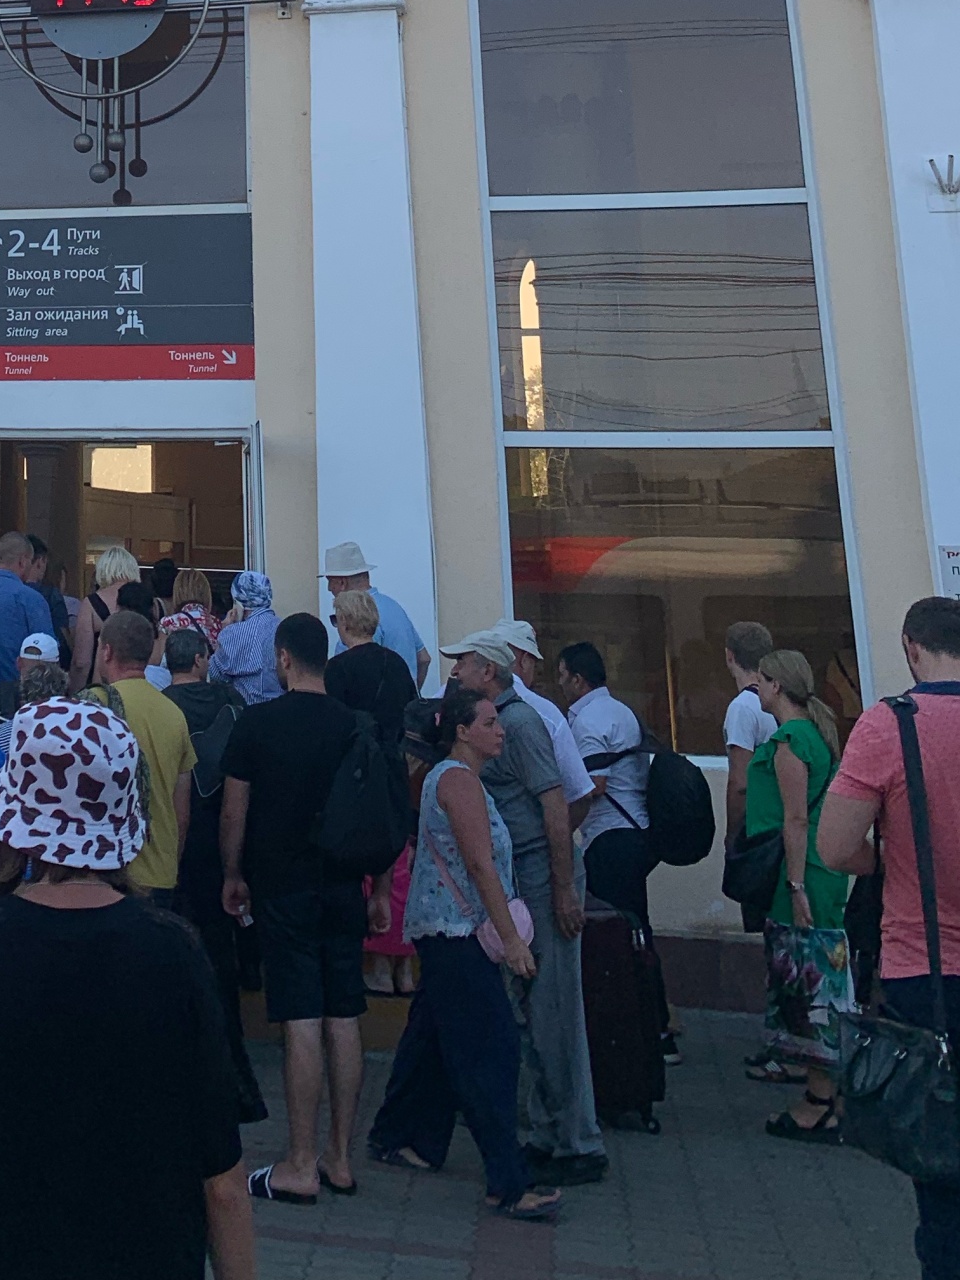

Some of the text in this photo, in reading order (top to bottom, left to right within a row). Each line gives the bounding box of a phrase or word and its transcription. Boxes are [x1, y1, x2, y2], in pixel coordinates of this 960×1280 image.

[67, 227, 101, 241] Пути
[7, 228, 62, 258] 2-4
[67, 245, 100, 256] Tracks
[6, 268, 106, 283] Выход в город
[7, 286, 55, 298] Way out
[6, 308, 109, 322] Зал ожидания
[6, 326, 68, 338] Sitting area
[5, 352, 49, 363] Тоннель
[168, 350, 215, 361] Тоннель
[4, 366, 33, 375] Tunnel
[188, 364, 218, 373] Tunnel
